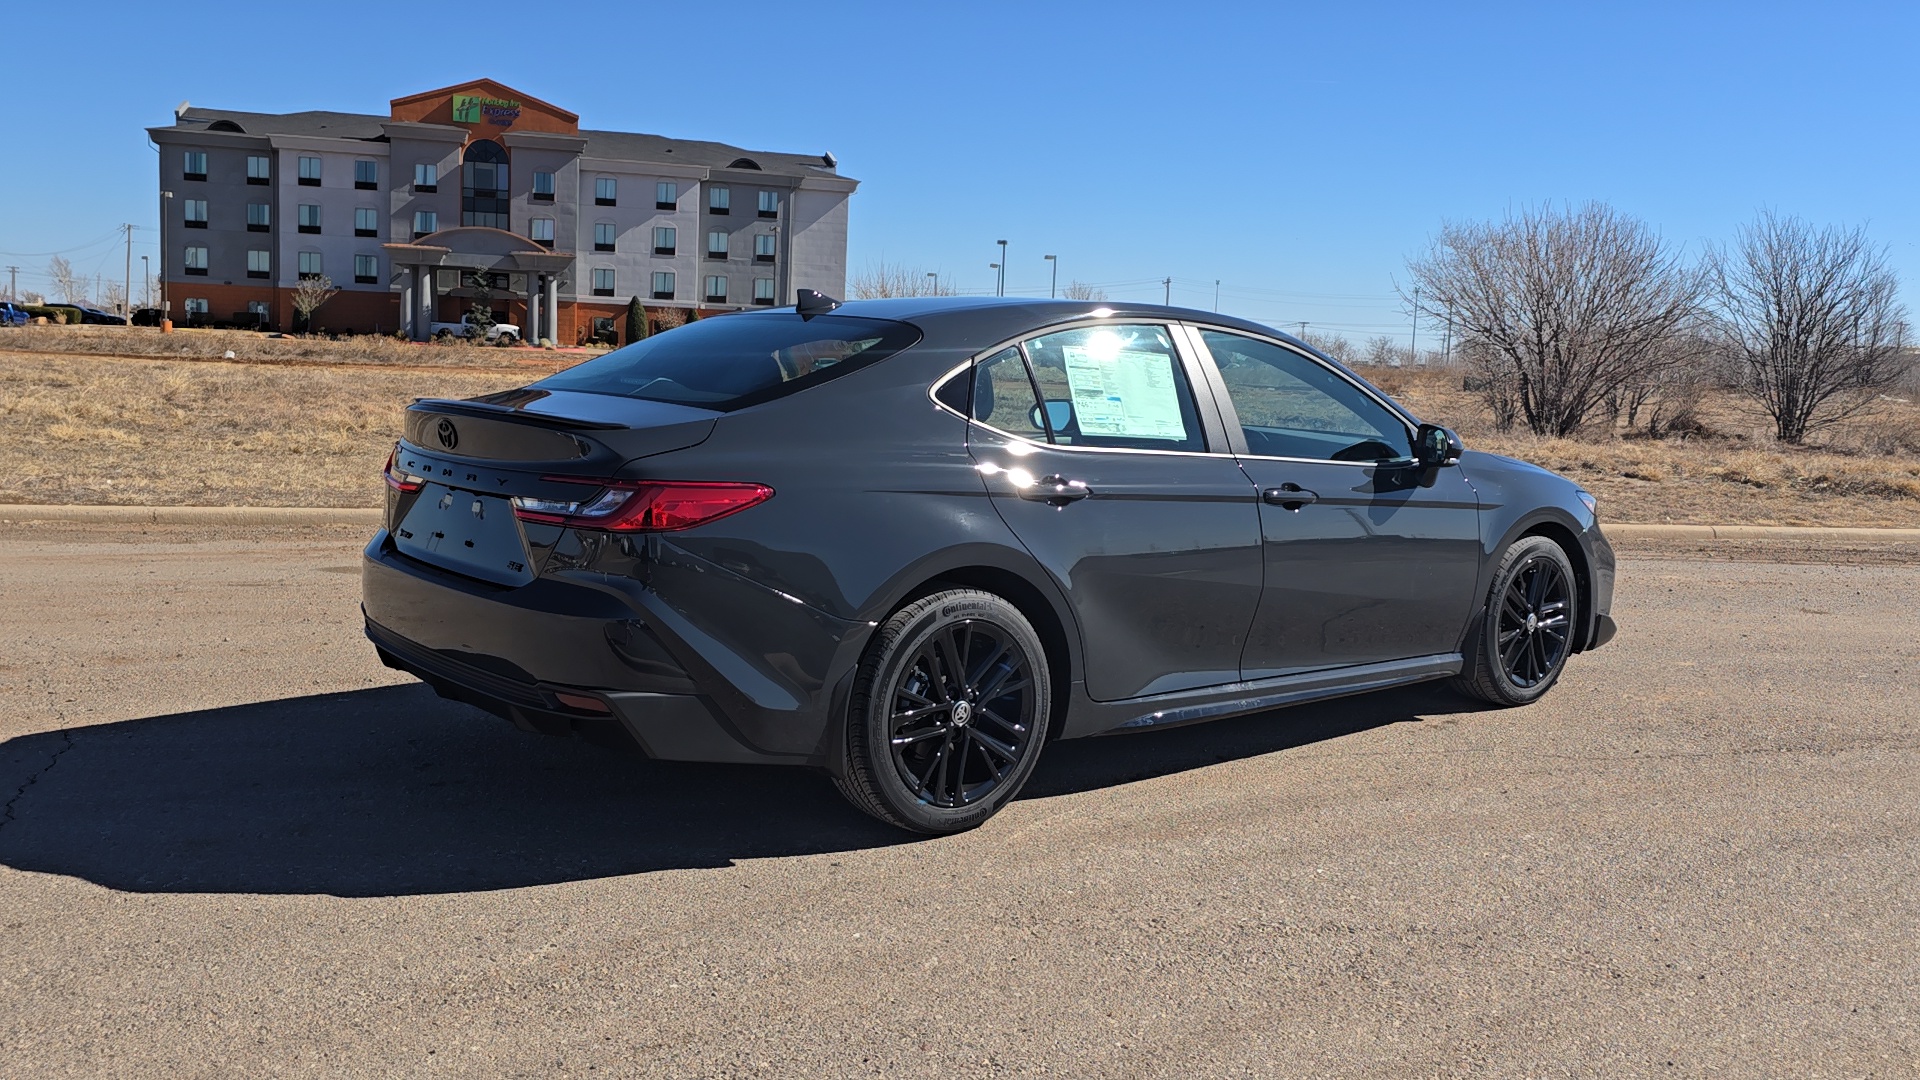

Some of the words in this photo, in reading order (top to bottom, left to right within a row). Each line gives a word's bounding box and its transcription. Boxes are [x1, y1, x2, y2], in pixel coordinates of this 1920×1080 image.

[482, 105, 521, 117] Express
[407, 460, 509, 487] CAMRY
[942, 601, 988, 618] Continental
